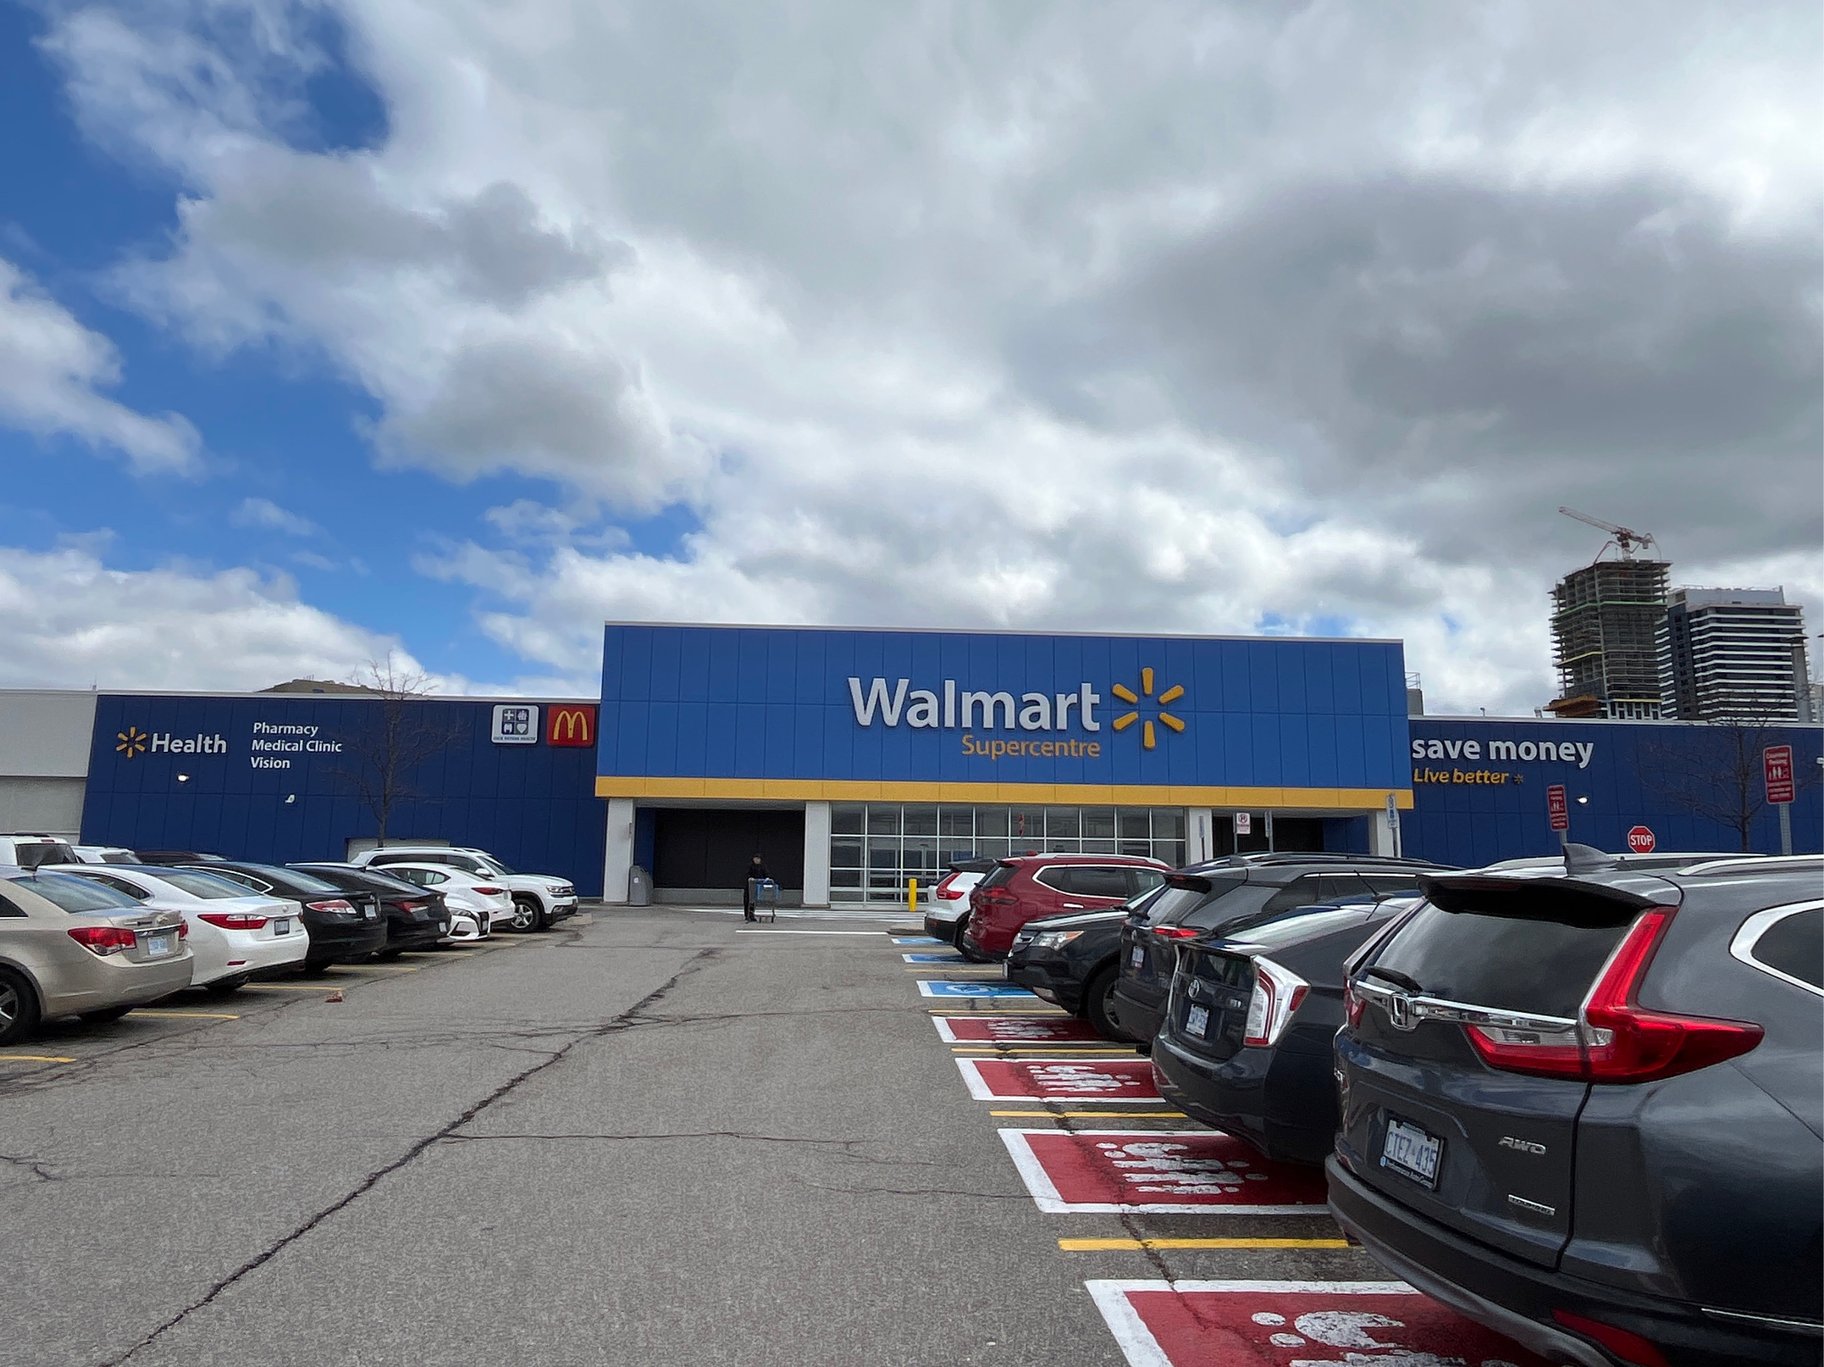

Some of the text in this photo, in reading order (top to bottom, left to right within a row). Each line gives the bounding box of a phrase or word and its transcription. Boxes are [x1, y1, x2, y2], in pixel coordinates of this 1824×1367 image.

[847, 677, 1100, 732] Walmart
[253, 722, 319, 737] Pharmacy
[151, 733, 227, 754] Health
[251, 739, 343, 753] Medical Clinic
[961, 734, 1101, 760] Supercentre
[250, 756, 291, 769] Vision
[1412, 739, 1594, 769] save money
[1413, 767, 1509, 784] Live better
[1630, 834, 1653, 846] STOP
